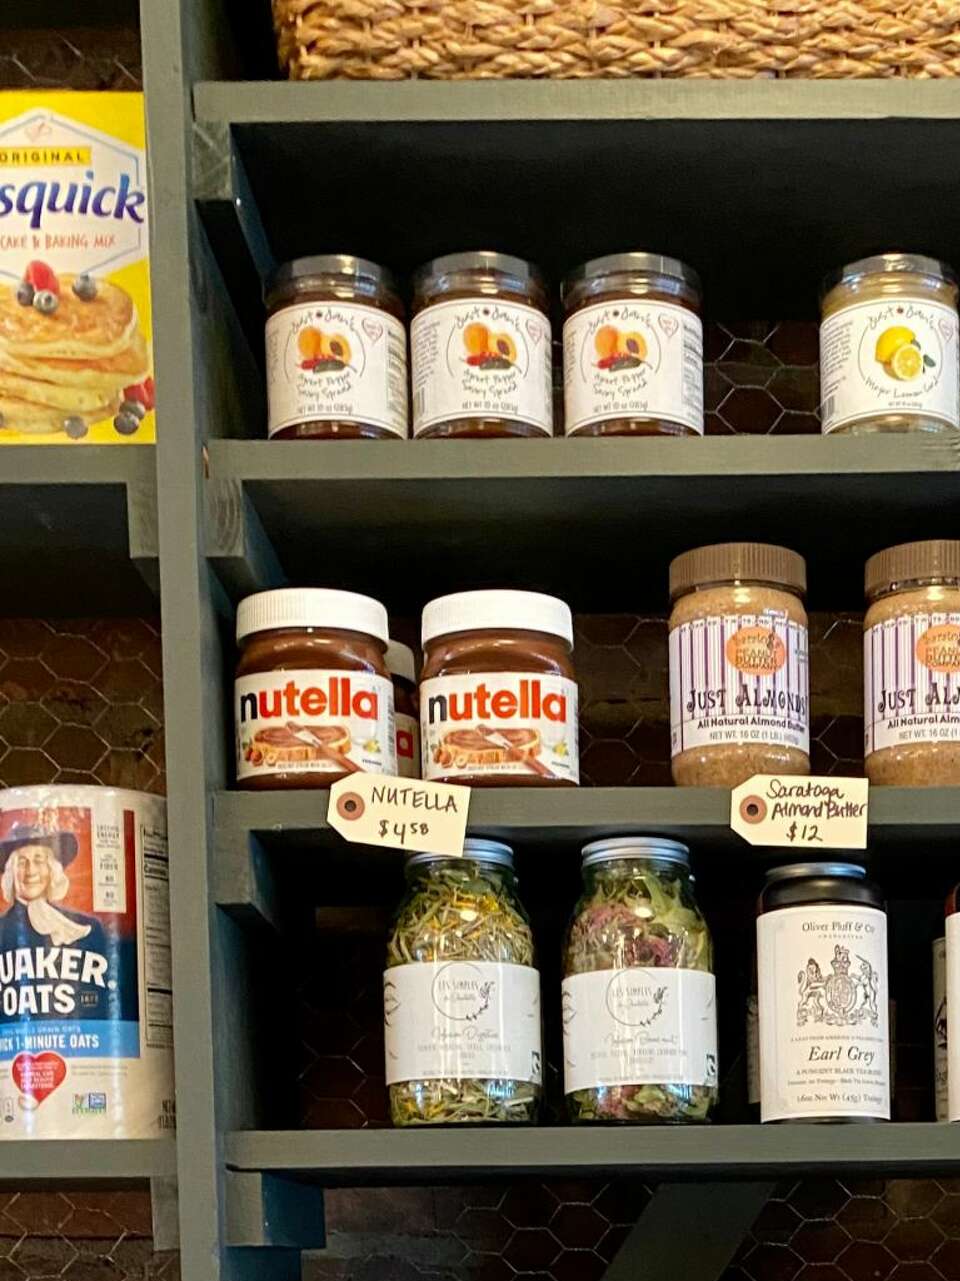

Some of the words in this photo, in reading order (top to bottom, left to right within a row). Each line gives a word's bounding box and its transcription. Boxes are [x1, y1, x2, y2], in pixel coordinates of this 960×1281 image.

[0, 151, 83, 165] ORIGINAL
[45, 234, 88, 249] BAKING
[94, 234, 117, 248] MIX
[240, 677, 379, 723] nutella
[428, 679, 568, 725] nutella
[686, 686, 727, 714] JUST
[734, 683, 807, 716] ALMONDS
[877, 687, 916, 714] JUST
[697, 719, 710, 730] All
[711, 716, 749, 729] Natural
[750, 716, 787, 729] Almond
[887, 719, 900, 730] All
[900, 716, 938, 728] Natural
[371, 785, 459, 813] NUTELLA
[766, 779, 844, 802] Saratoga
[771, 801, 825, 821] Almond
[826, 802, 867, 820] Butter
[786, 825, 823, 843] $12
[802, 921, 829, 933] Oliver
[832, 920, 853, 933] Pluff
[854, 922, 863, 933] &
[0, 947, 109, 988] UAKER
[3, 983, 76, 1017] OATS
[70, 1034, 100, 1048] OATS
[808, 1045, 843, 1061] Earl
[847, 1045, 875, 1066] Grey
